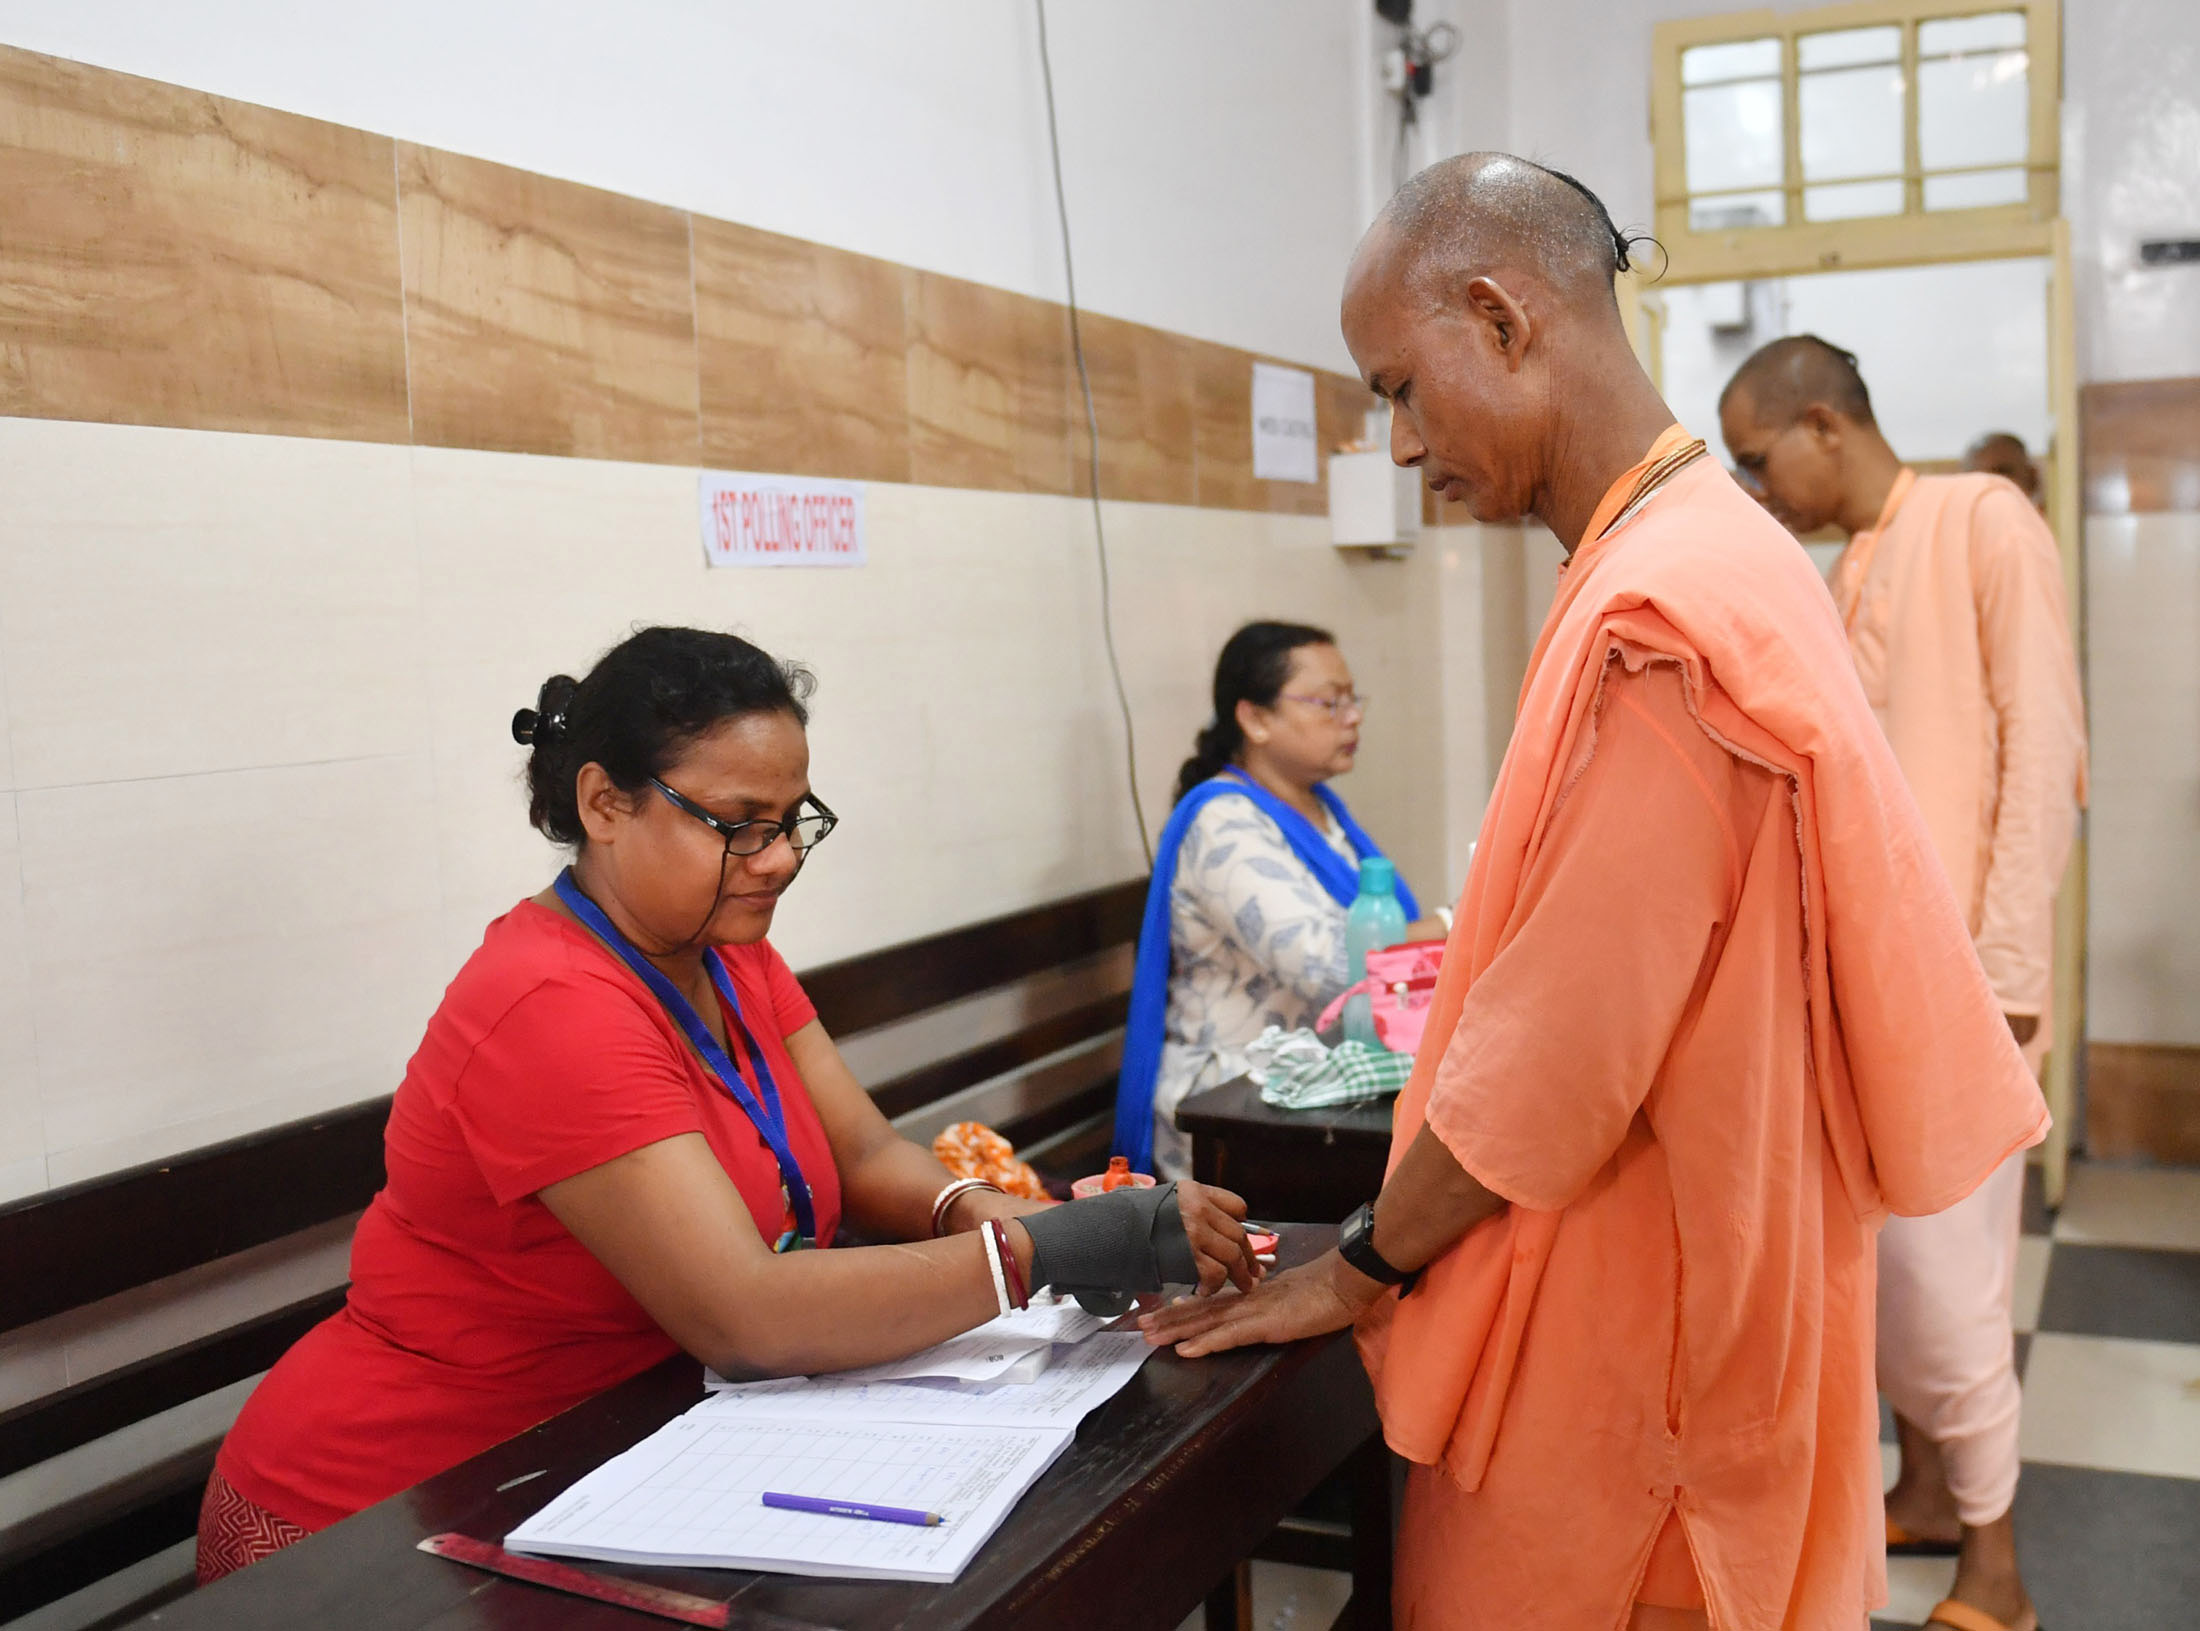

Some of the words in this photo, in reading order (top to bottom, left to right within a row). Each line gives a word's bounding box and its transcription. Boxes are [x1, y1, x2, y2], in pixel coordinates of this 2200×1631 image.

[712, 490, 739, 551] 1ST
[742, 491, 801, 551] POLLING
[803, 493, 858, 552] OFFICER
